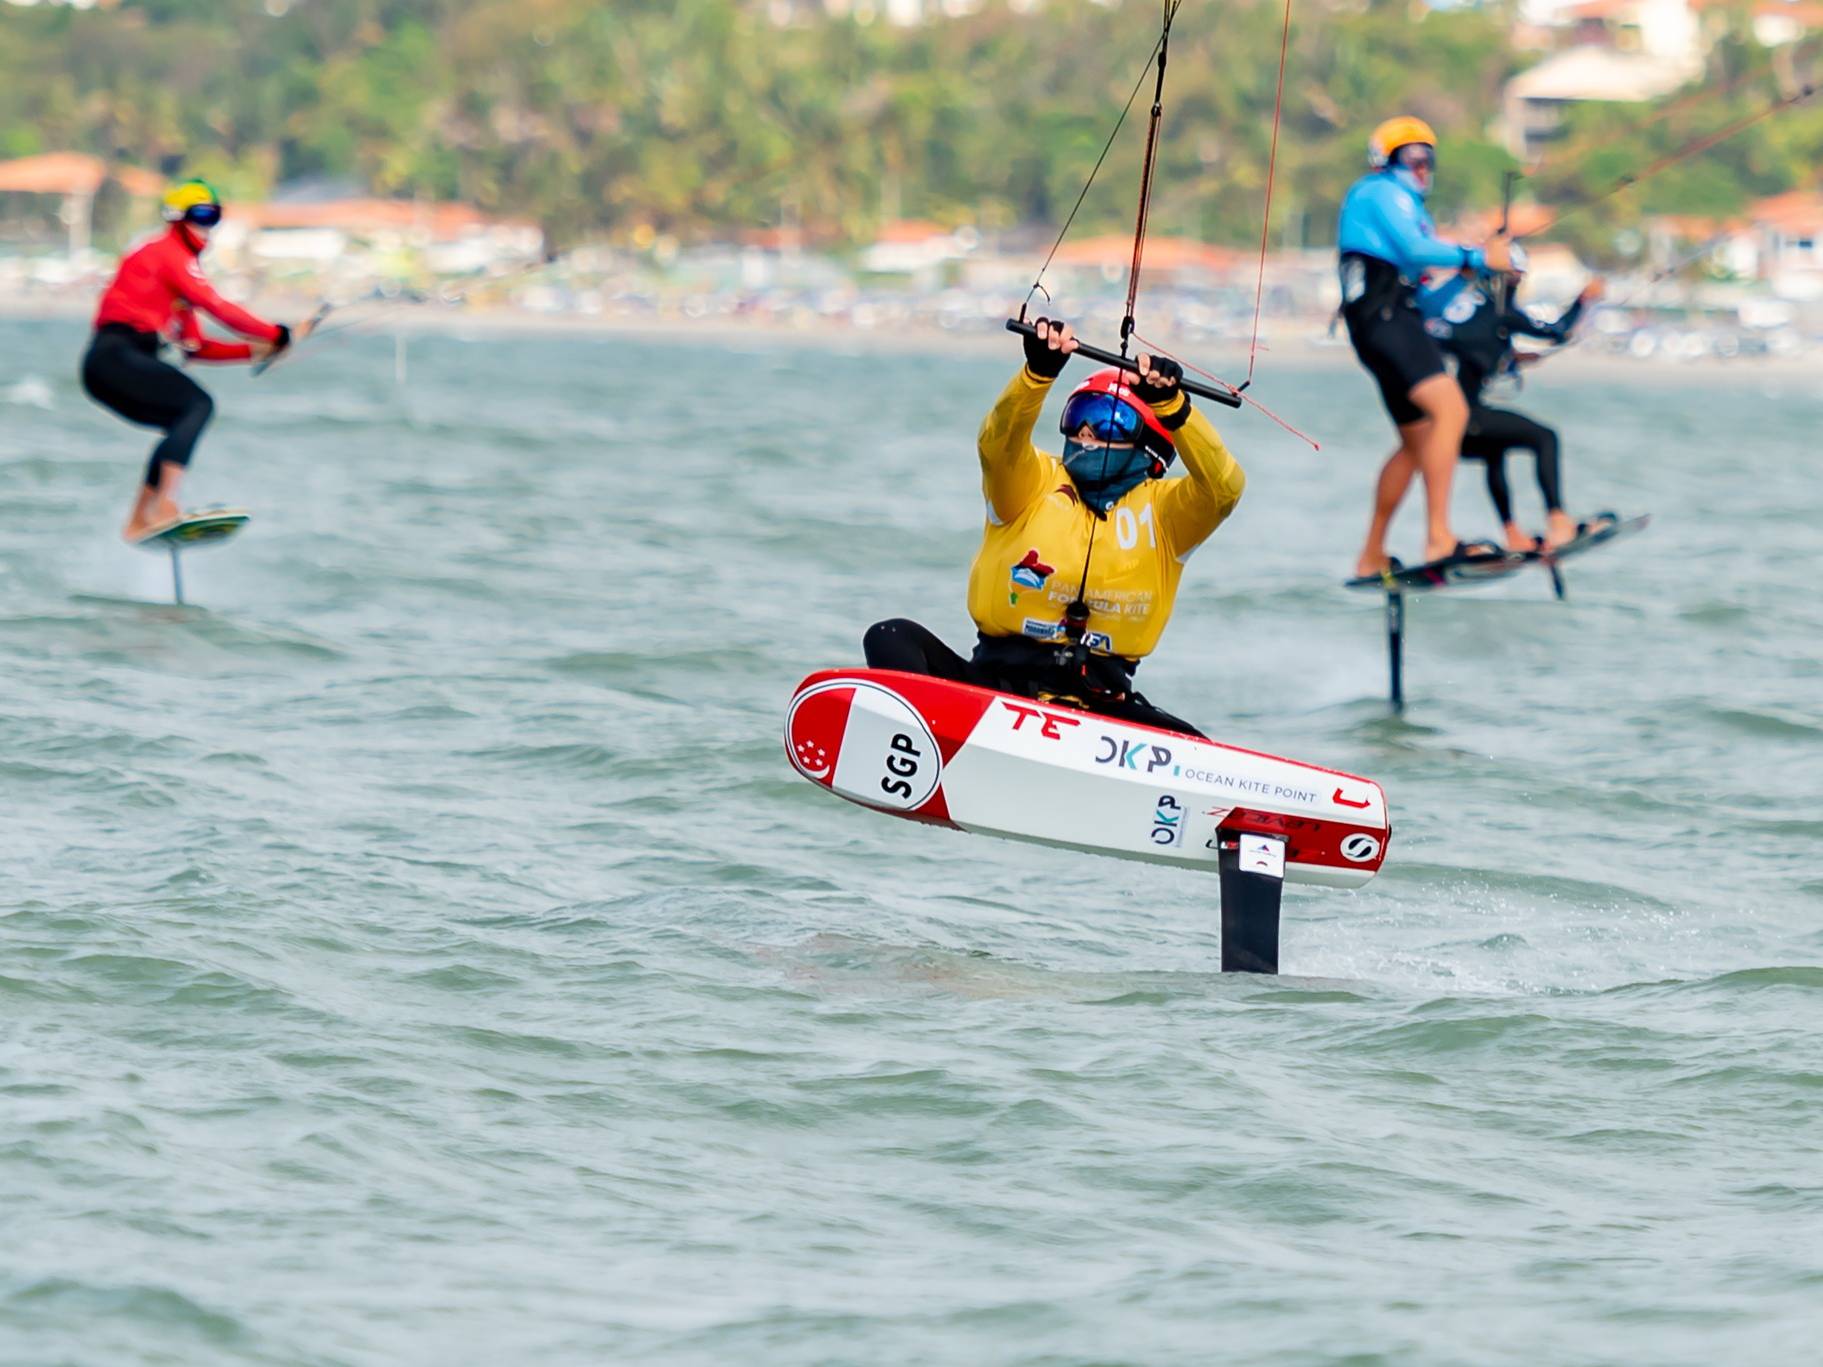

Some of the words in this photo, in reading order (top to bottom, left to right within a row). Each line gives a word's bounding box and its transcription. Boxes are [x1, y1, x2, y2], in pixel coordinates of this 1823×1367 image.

[1115, 503, 1156, 550] 01
[881, 733, 921, 799] SGP
[1184, 768, 1235, 787] OCEAN
[1238, 779, 1271, 794] KITE
[1274, 786, 1318, 803] POINT
